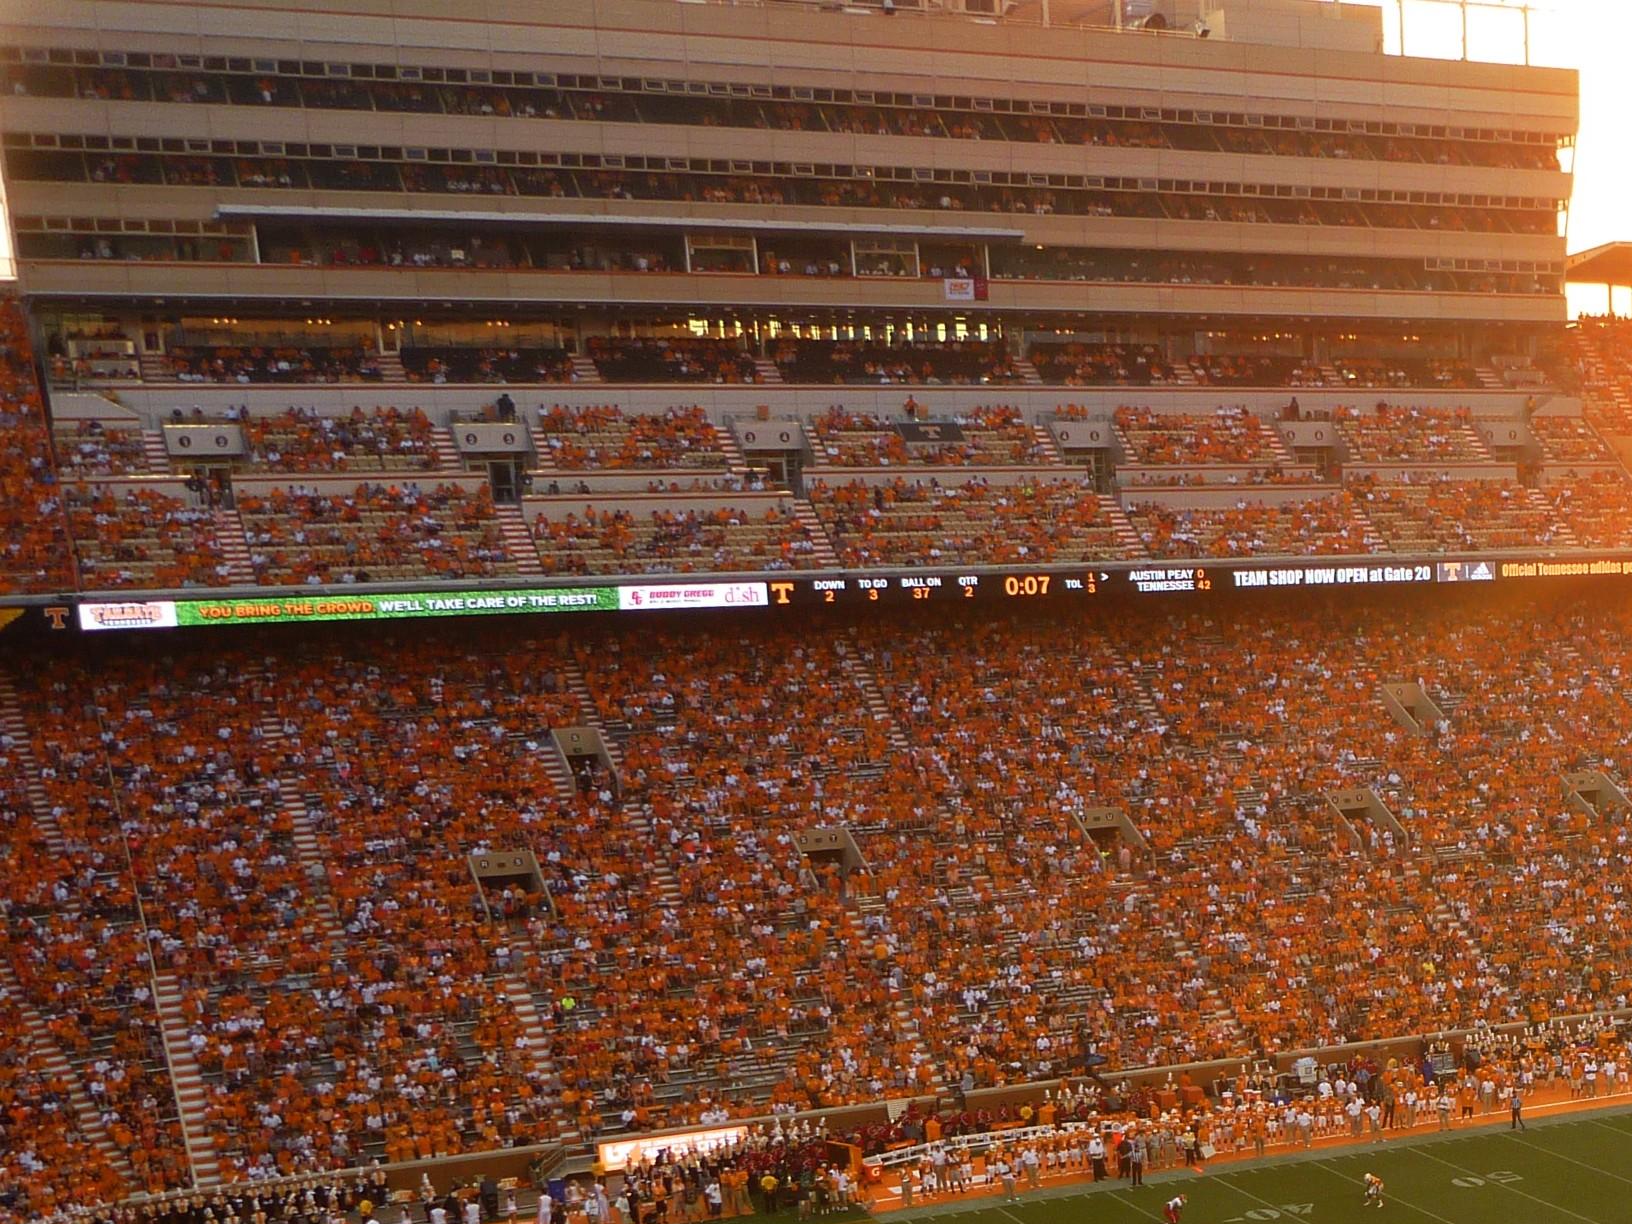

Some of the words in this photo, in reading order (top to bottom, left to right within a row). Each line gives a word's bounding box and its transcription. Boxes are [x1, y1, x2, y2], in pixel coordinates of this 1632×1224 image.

[1088, 572, 1095, 582] 1
[1129, 570, 1166, 581] AUSTIN
[1167, 569, 1193, 580] PEAY
[1197, 569, 1204, 578] 0
[1234, 571, 1267, 587] TEAM
[1269, 570, 1303, 586] SHOP
[1305, 569, 1335, 584] NOW
[1337, 567, 1368, 583] OPEN
[1369, 569, 1381, 582] at
[1384, 567, 1413, 582] Gate
[1415, 566, 1431, 581] 20
[1444, 563, 1461, 581] T
[1502, 561, 1536, 577] Official
[1538, 561, 1588, 576] Tennessee
[1590, 559, 1621, 575] adidas
[814, 580, 845, 590] DOWN
[859, 579, 872, 589] TO
[873, 578, 887, 588] GO
[901, 578, 924, 587] BALL
[926, 577, 941, 587] ON
[959, 576, 977, 586] QTR
[1005, 576, 1050, 596] 0:07
[1066, 579, 1083, 589] TOL
[1088, 583, 1096, 593] 3
[1137, 581, 1194, 592] TENNESSEE
[1198, 580, 1211, 590] 42
[725, 586, 760, 604] dish
[771, 583, 794, 603] T
[825, 591, 835, 602] 2
[869, 589, 878, 600] 3
[913, 587, 930, 599] 37
[964, 587, 974, 597] 2
[200, 608, 233, 618] YOU
[236, 606, 281, 617] BRING
[284, 604, 312, 615] THE
[379, 599, 423, 613] WE'LL
[425, 598, 464, 610] TAKE
[467, 597, 505, 609] CARE
[508, 596, 526, 607] OF
[529, 595, 556, 607] THE
[559, 593, 598, 606] REST!
[44, 607, 69, 629] T
